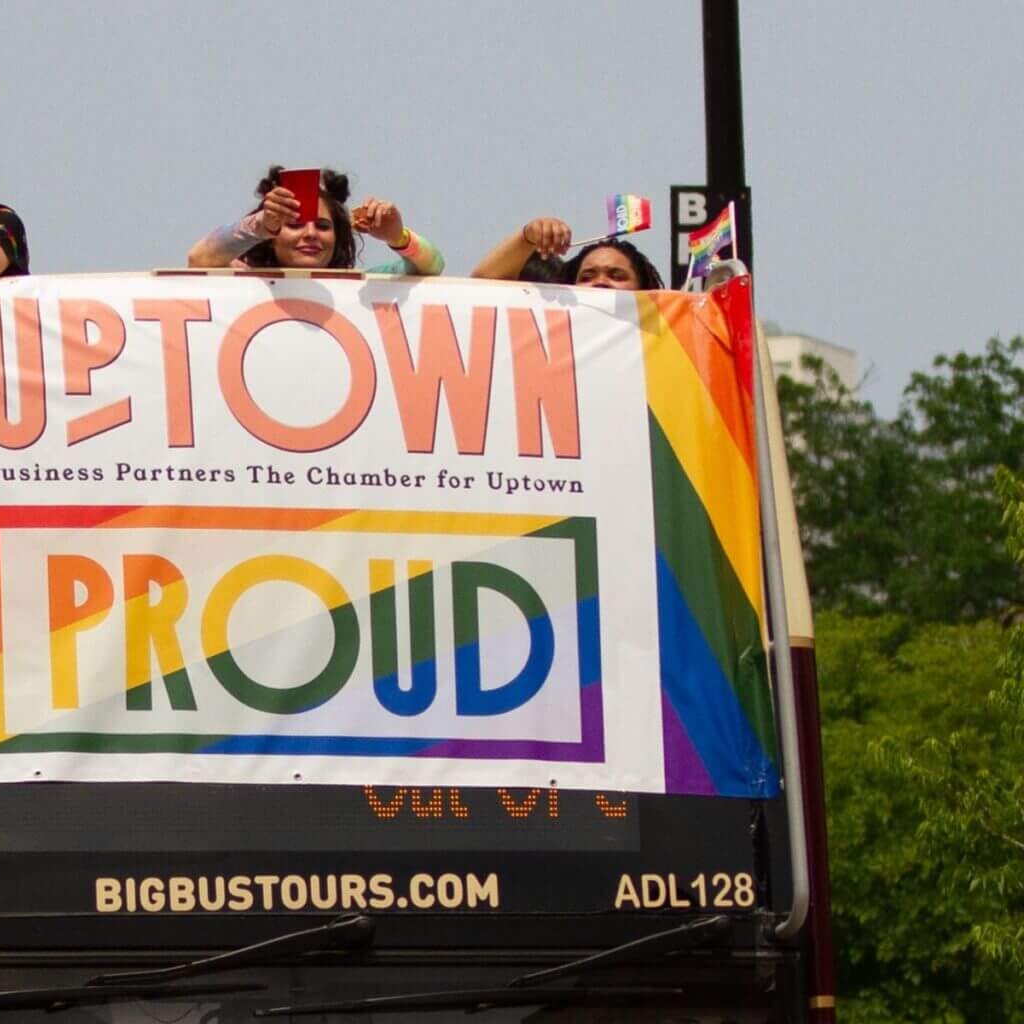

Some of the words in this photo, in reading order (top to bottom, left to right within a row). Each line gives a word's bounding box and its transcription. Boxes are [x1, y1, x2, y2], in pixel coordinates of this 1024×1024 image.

[116, 462, 236, 483] Partners
[246, 465, 295, 484] The
[307, 466, 426, 488] Chamber
[437, 469, 475, 489] for
[487, 471, 584, 494] Uptown
[47, 553, 555, 717] PROUD
[95, 872, 499, 912] BIGBUSTOURS.COM
[614, 872, 755, 909] ADL128
